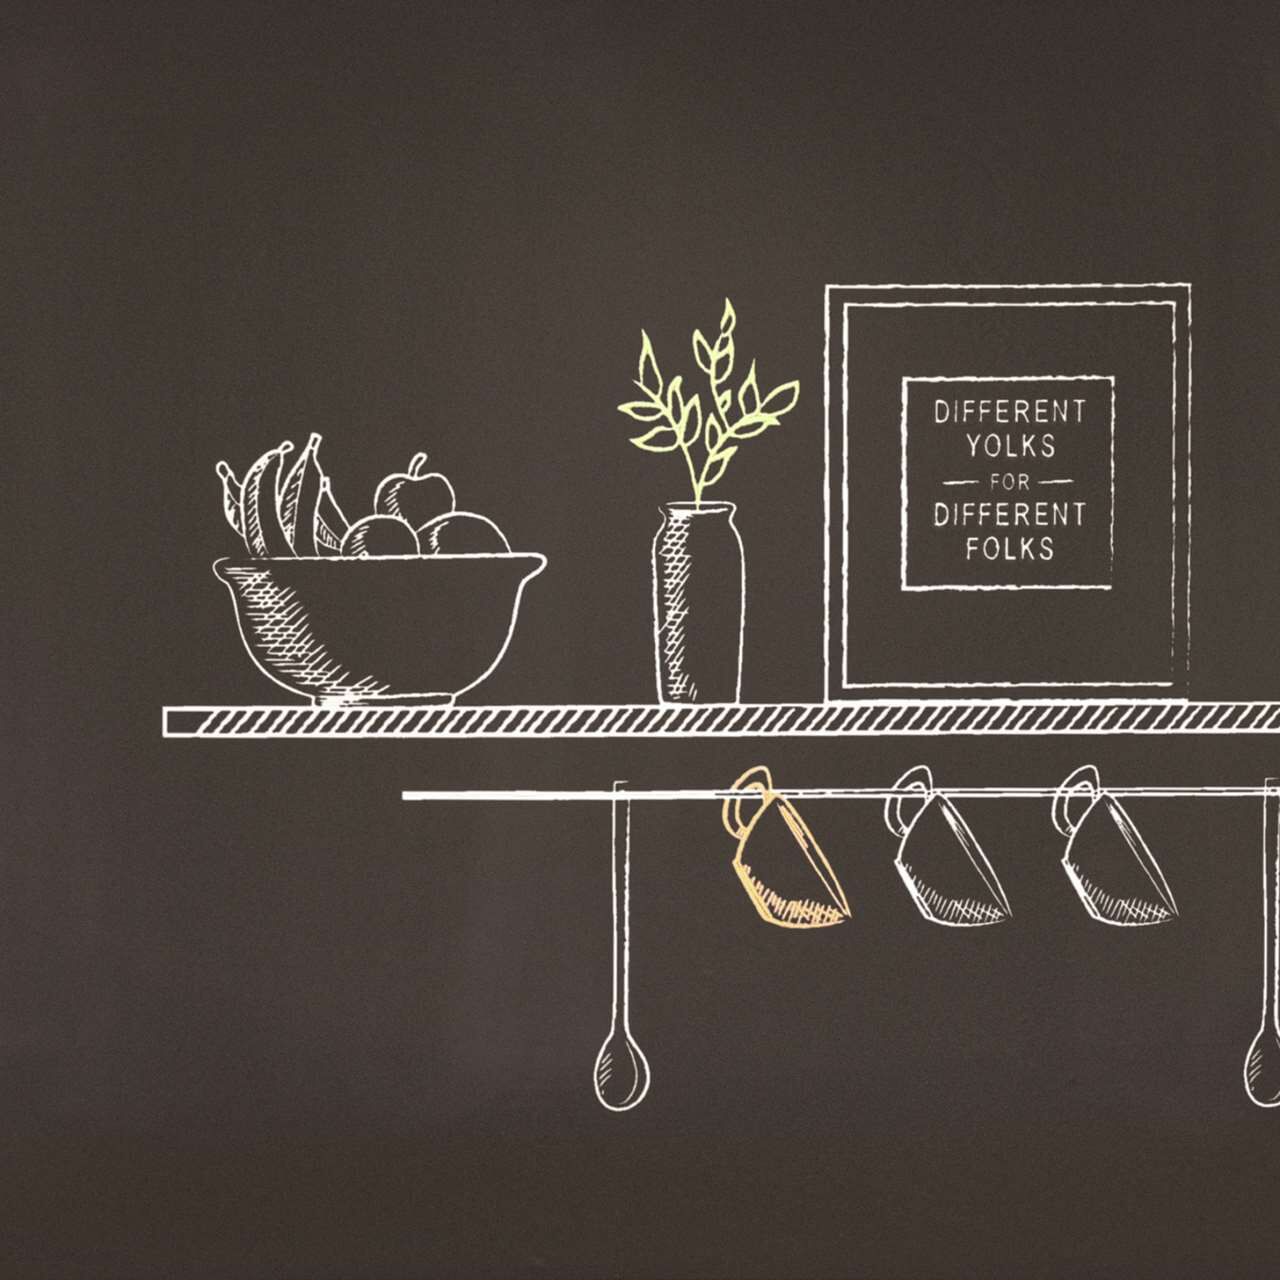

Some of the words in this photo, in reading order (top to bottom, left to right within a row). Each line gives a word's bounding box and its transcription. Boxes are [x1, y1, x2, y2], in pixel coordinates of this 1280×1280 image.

[935, 399, 1086, 424] DIFFERENT
[966, 433, 1055, 458] YOLKS
[990, 473, 1030, 491] FOR
[934, 502, 1086, 527] DIFFERENT
[966, 536, 1054, 561] FOLKS
